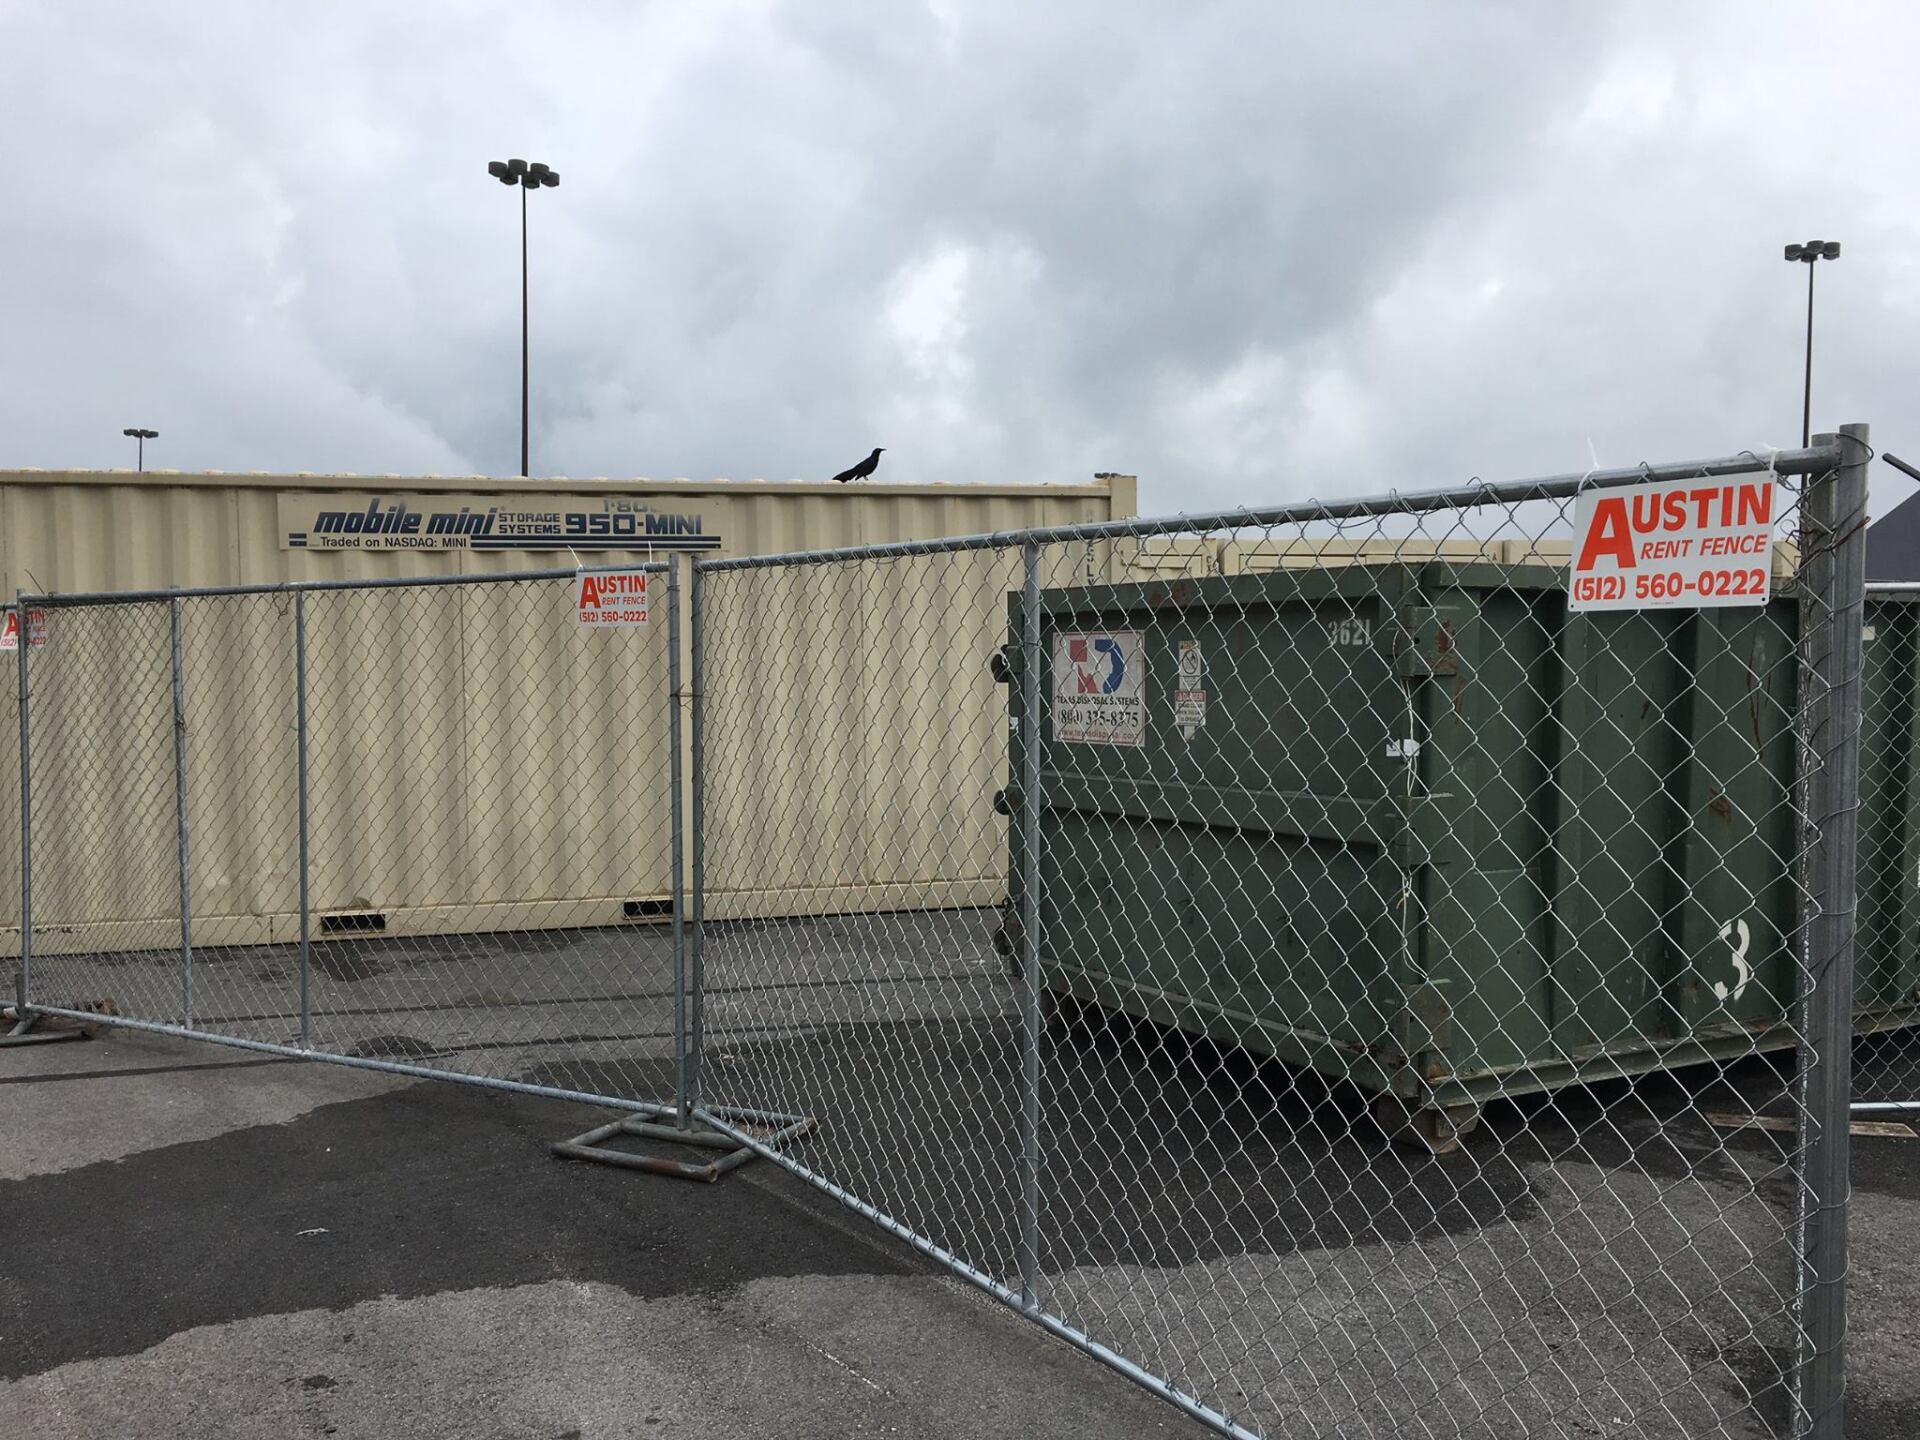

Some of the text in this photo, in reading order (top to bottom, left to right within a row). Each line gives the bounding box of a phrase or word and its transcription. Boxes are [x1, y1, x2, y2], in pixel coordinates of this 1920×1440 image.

[313, 497, 498, 534] mobile mini
[499, 513, 561, 523] STORAGE
[565, 513, 702, 535] 950-MINI
[1576, 482, 1773, 571] AUSTIN
[499, 524, 561, 534] SYSTEMS
[320, 537, 360, 547] Traded
[365, 539, 380, 547] on
[385, 537, 437, 548] NASDAQ:
[442, 538, 467, 547] MINI
[1640, 534, 1768, 560] RENT FENCE
[579, 575, 646, 609] AUSTIN
[1574, 568, 1765, 601] (512) 560-0222
[602, 596, 645, 606] RENT FENCE
[579, 610, 647, 622] (512) 560-0222
[1714, 917, 1751, 1001] 3
